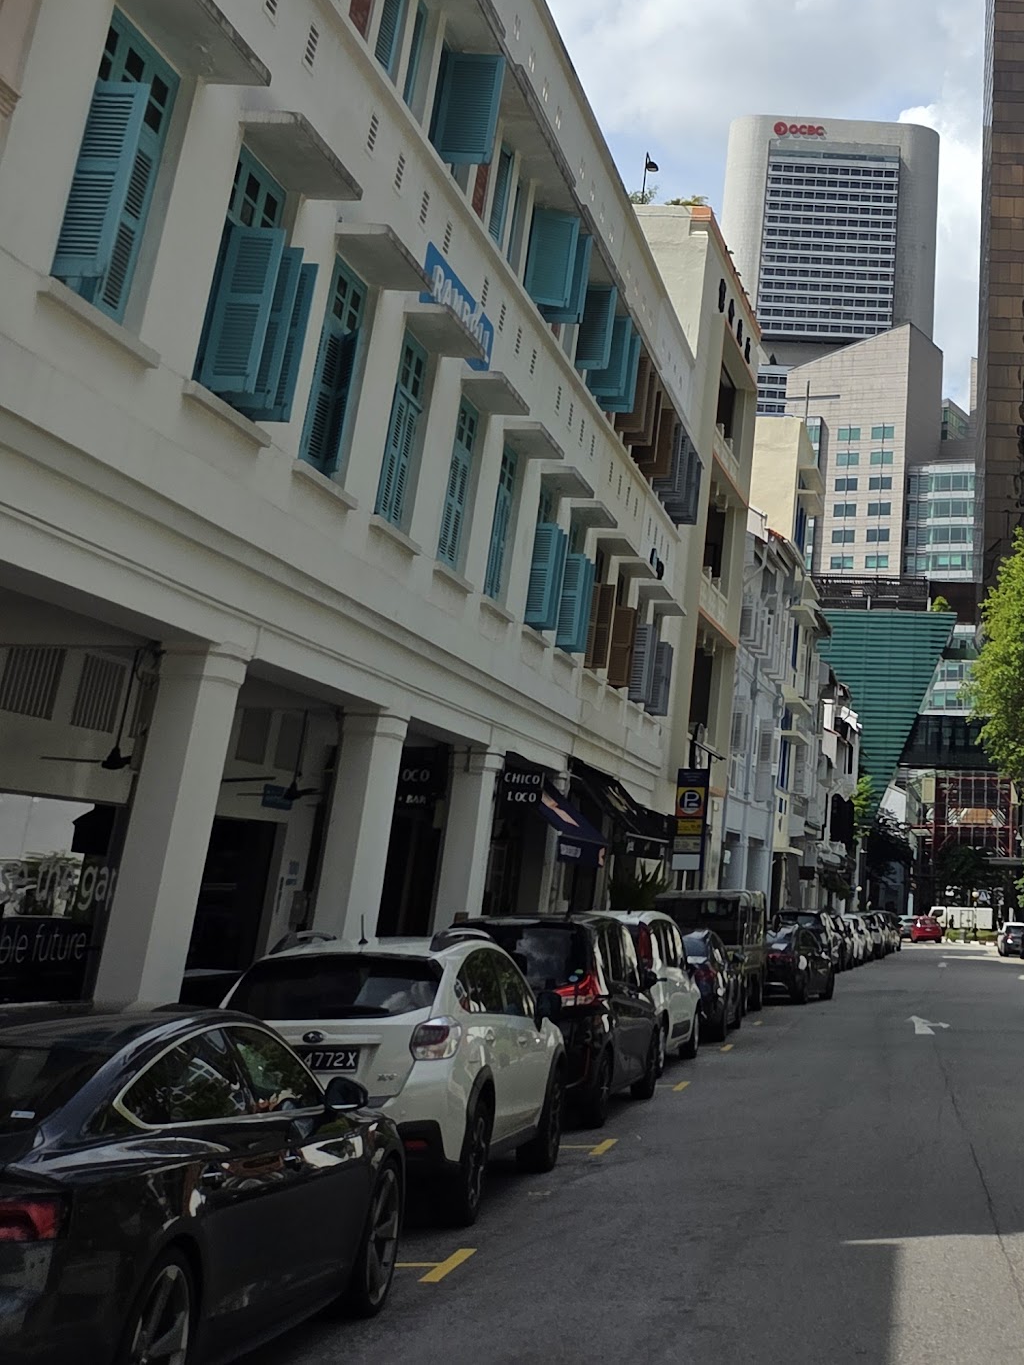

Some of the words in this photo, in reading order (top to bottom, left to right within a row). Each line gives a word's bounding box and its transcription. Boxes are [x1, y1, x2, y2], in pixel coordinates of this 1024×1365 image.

[788, 123, 825, 136] OCBC
[402, 768, 431, 782] OCO
[504, 771, 541, 785] CHICO
[506, 790, 537, 803] LOCO
[32, 923, 87, 962] future
